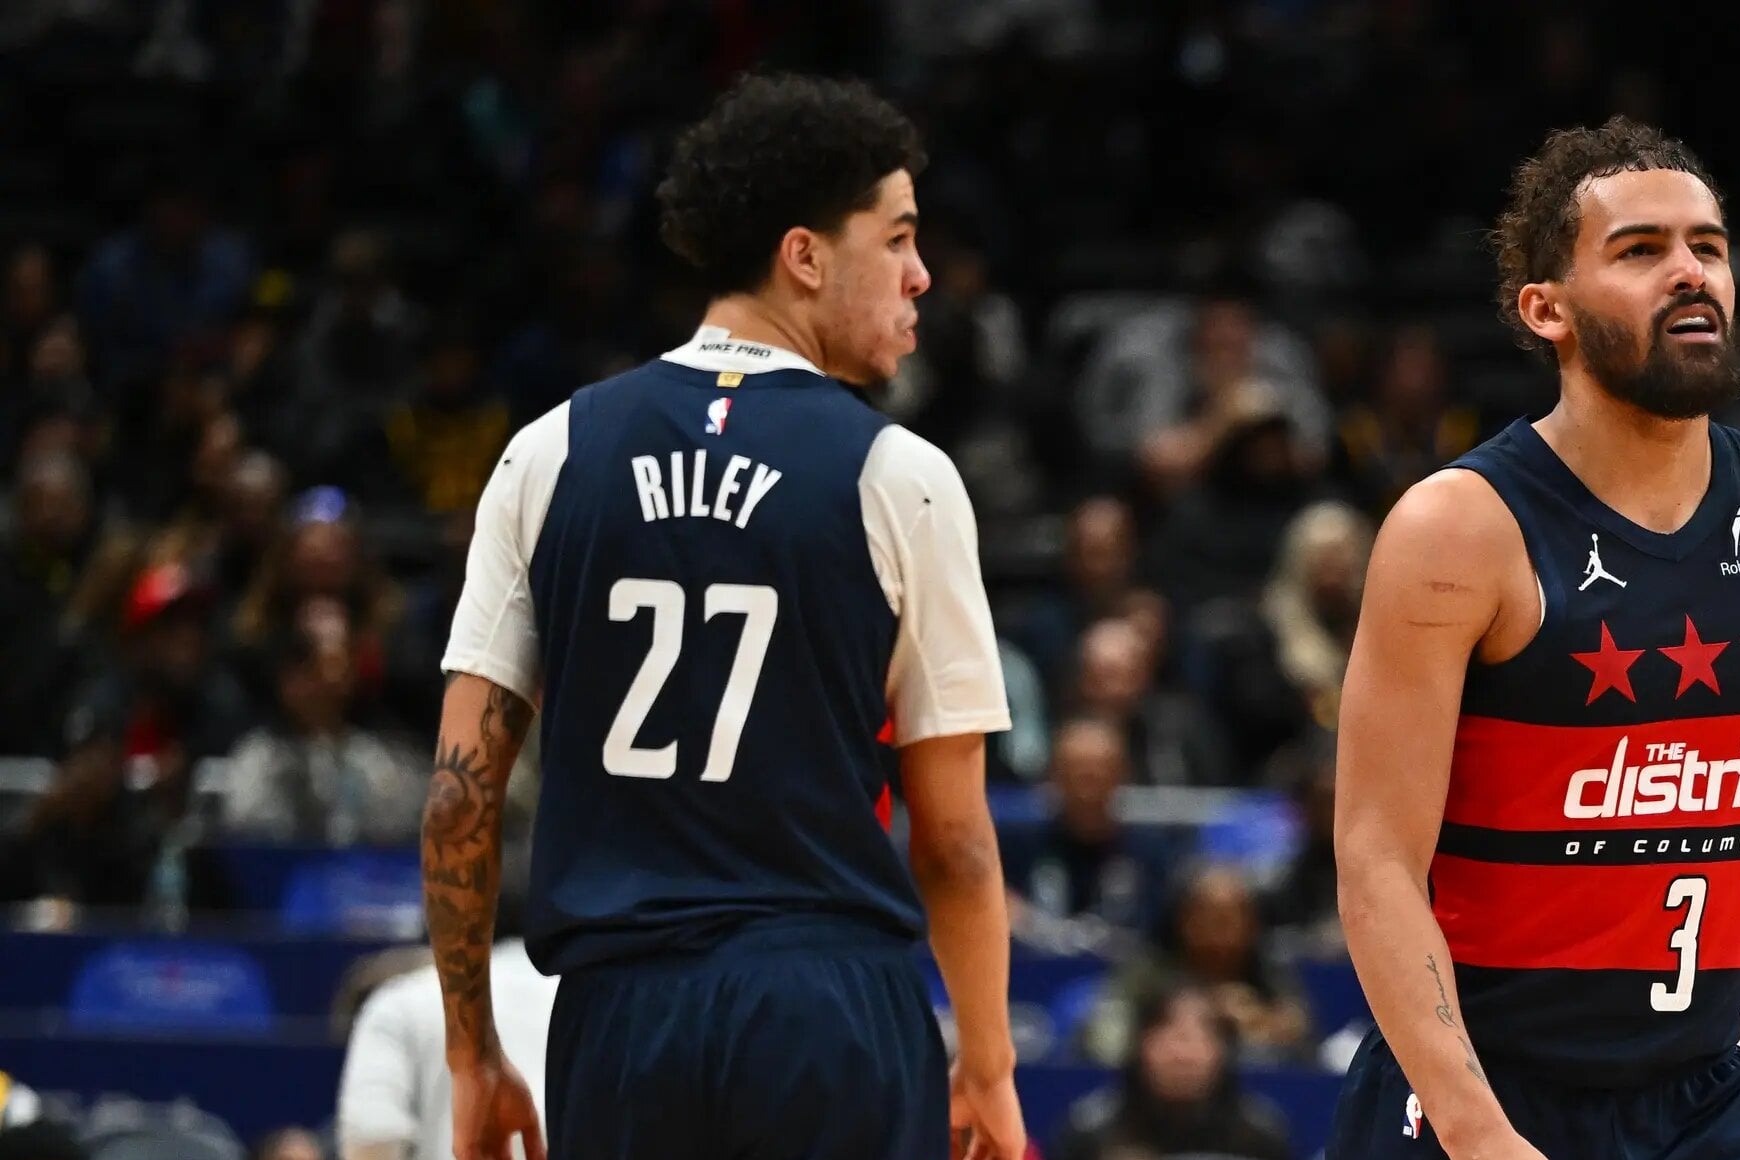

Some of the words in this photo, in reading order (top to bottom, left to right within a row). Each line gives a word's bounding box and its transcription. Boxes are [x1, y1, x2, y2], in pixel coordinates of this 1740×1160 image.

[700, 343, 732, 352] NIKE
[736, 344, 772, 358] PRO
[631, 449, 782, 529] RILEY
[602, 577, 778, 782] 27
[1646, 742, 1687, 762] THE
[1565, 840, 1606, 855] OF
[1650, 878, 1707, 1012] 3
